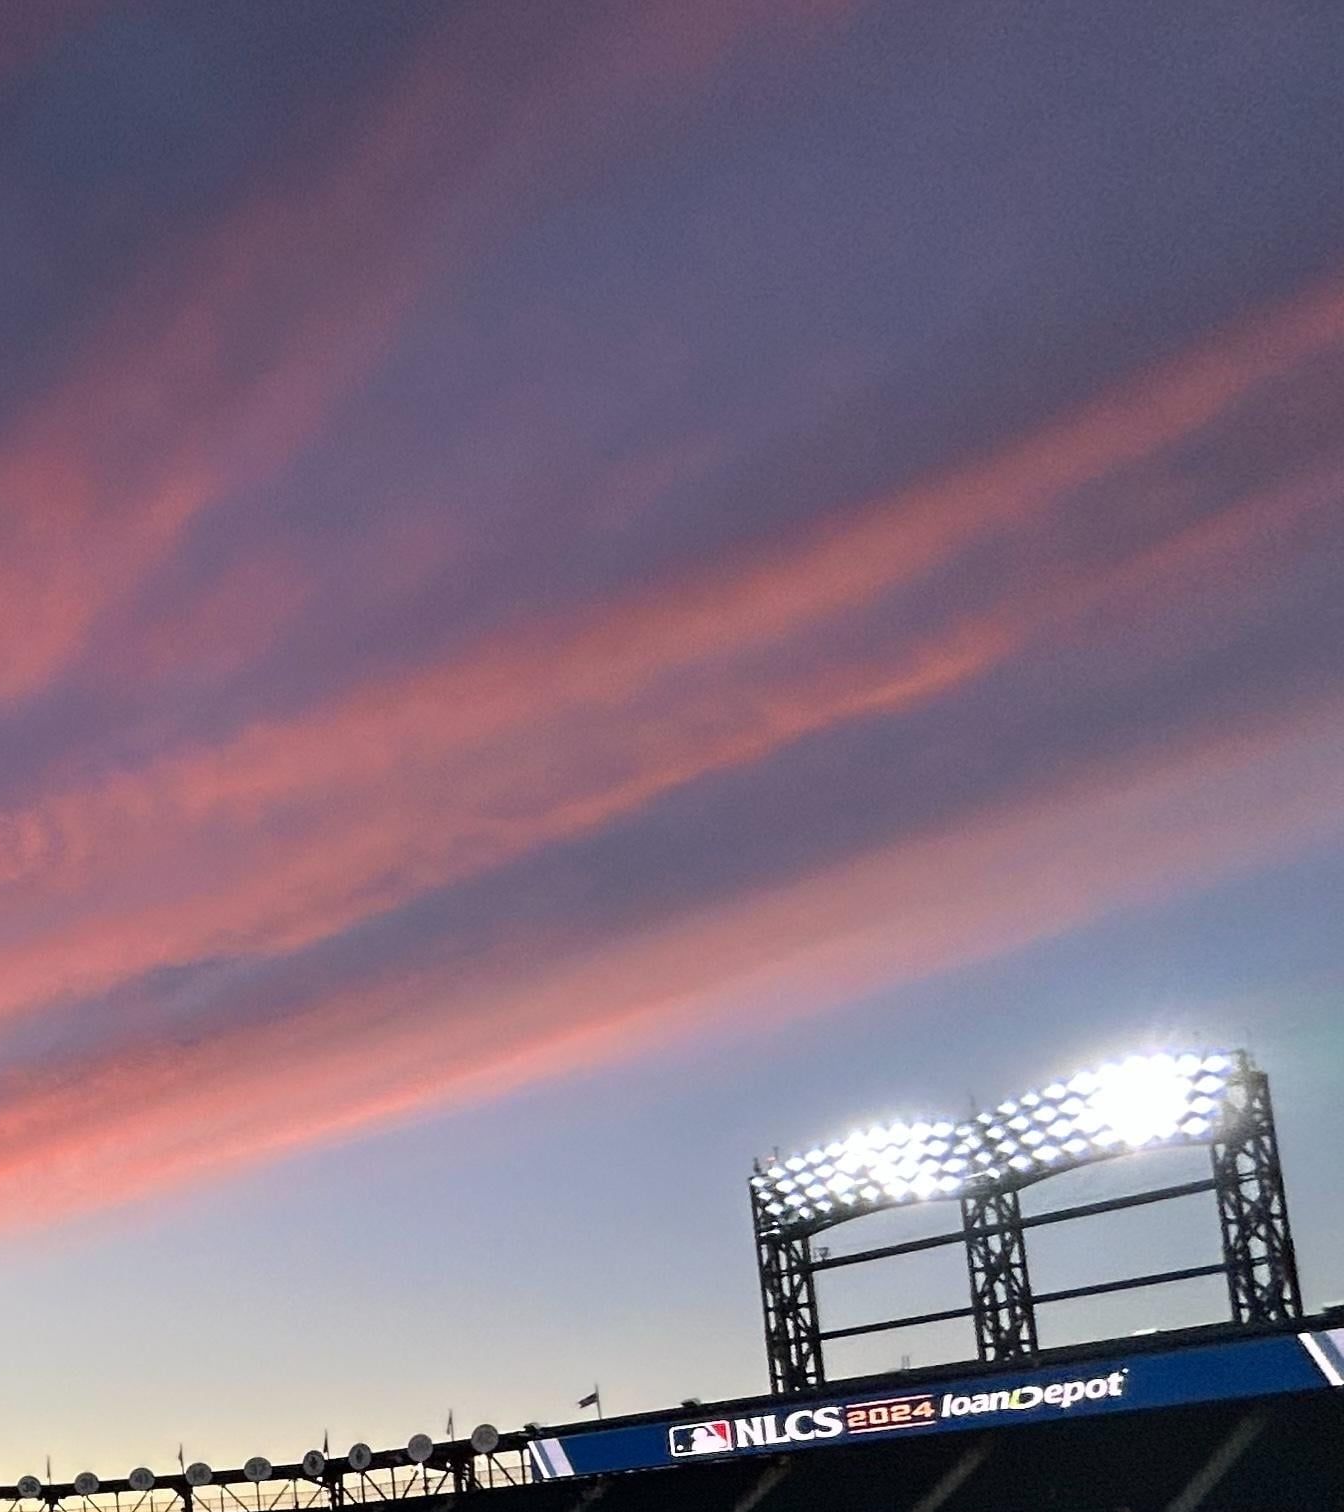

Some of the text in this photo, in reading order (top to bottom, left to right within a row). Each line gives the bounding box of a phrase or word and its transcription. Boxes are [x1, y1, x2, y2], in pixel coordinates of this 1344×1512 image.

[734, 1371, 1126, 1447] NLCS 2024 loanDepot
